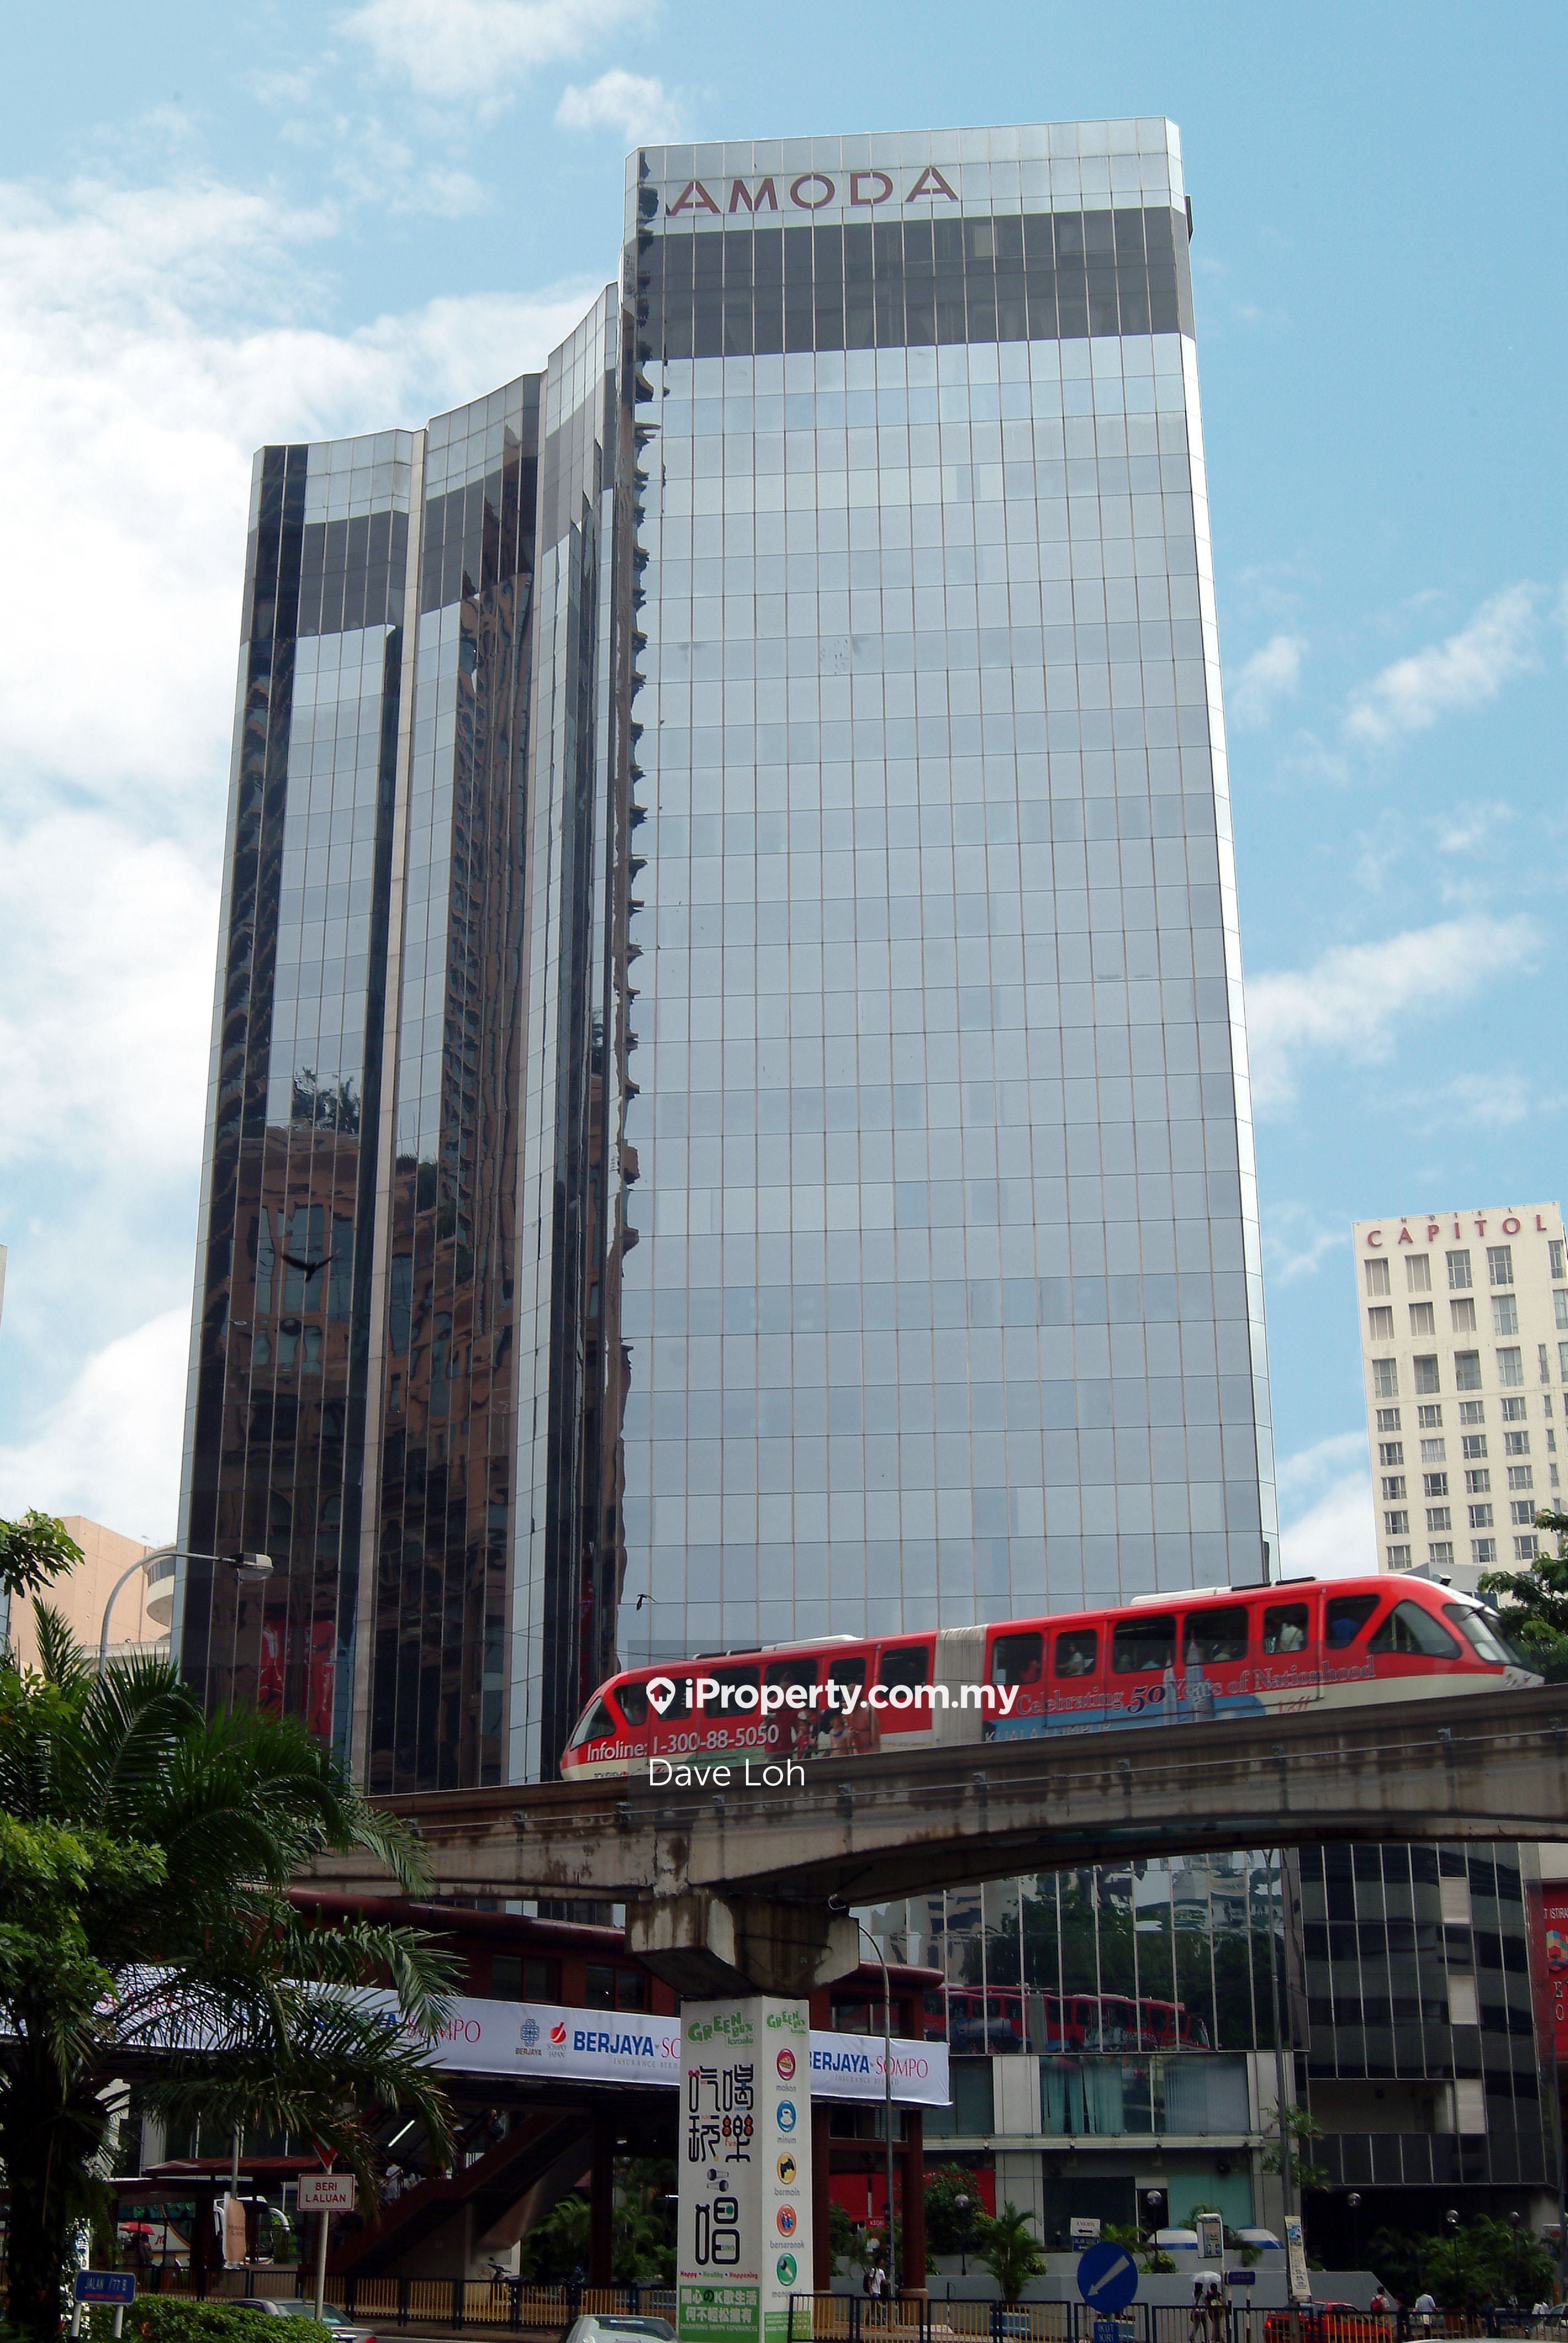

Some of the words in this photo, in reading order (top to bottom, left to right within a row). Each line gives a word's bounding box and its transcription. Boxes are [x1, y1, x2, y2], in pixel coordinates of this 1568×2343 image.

[667, 167, 959, 216] AMODA
[1366, 1214, 1547, 1247] CAPITOL
[1017, 1687, 1124, 1714] Celebrating
[1128, 1685, 1166, 1714] 50
[1228, 1670, 1251, 1694] of
[1254, 1655, 1376, 1690] Nationhood
[587, 1741, 647, 1762] Infoline:
[653, 1724, 779, 1754] 1-300-88-5050
[688, 2012, 742, 2042] GREEN
[766, 2010, 799, 2029] GREEN
[515, 2047, 542, 2056] BERJAYA
[573, 2030, 654, 2057] BERJAYA
[613, 2057, 655, 2068] INSURANCE
[809, 2051, 870, 2074] ERJAYA
[875, 2055, 929, 2079] SOMPO
[305, 2193, 346, 2203] LALUAN
[315, 2182, 337, 2191] BERI
